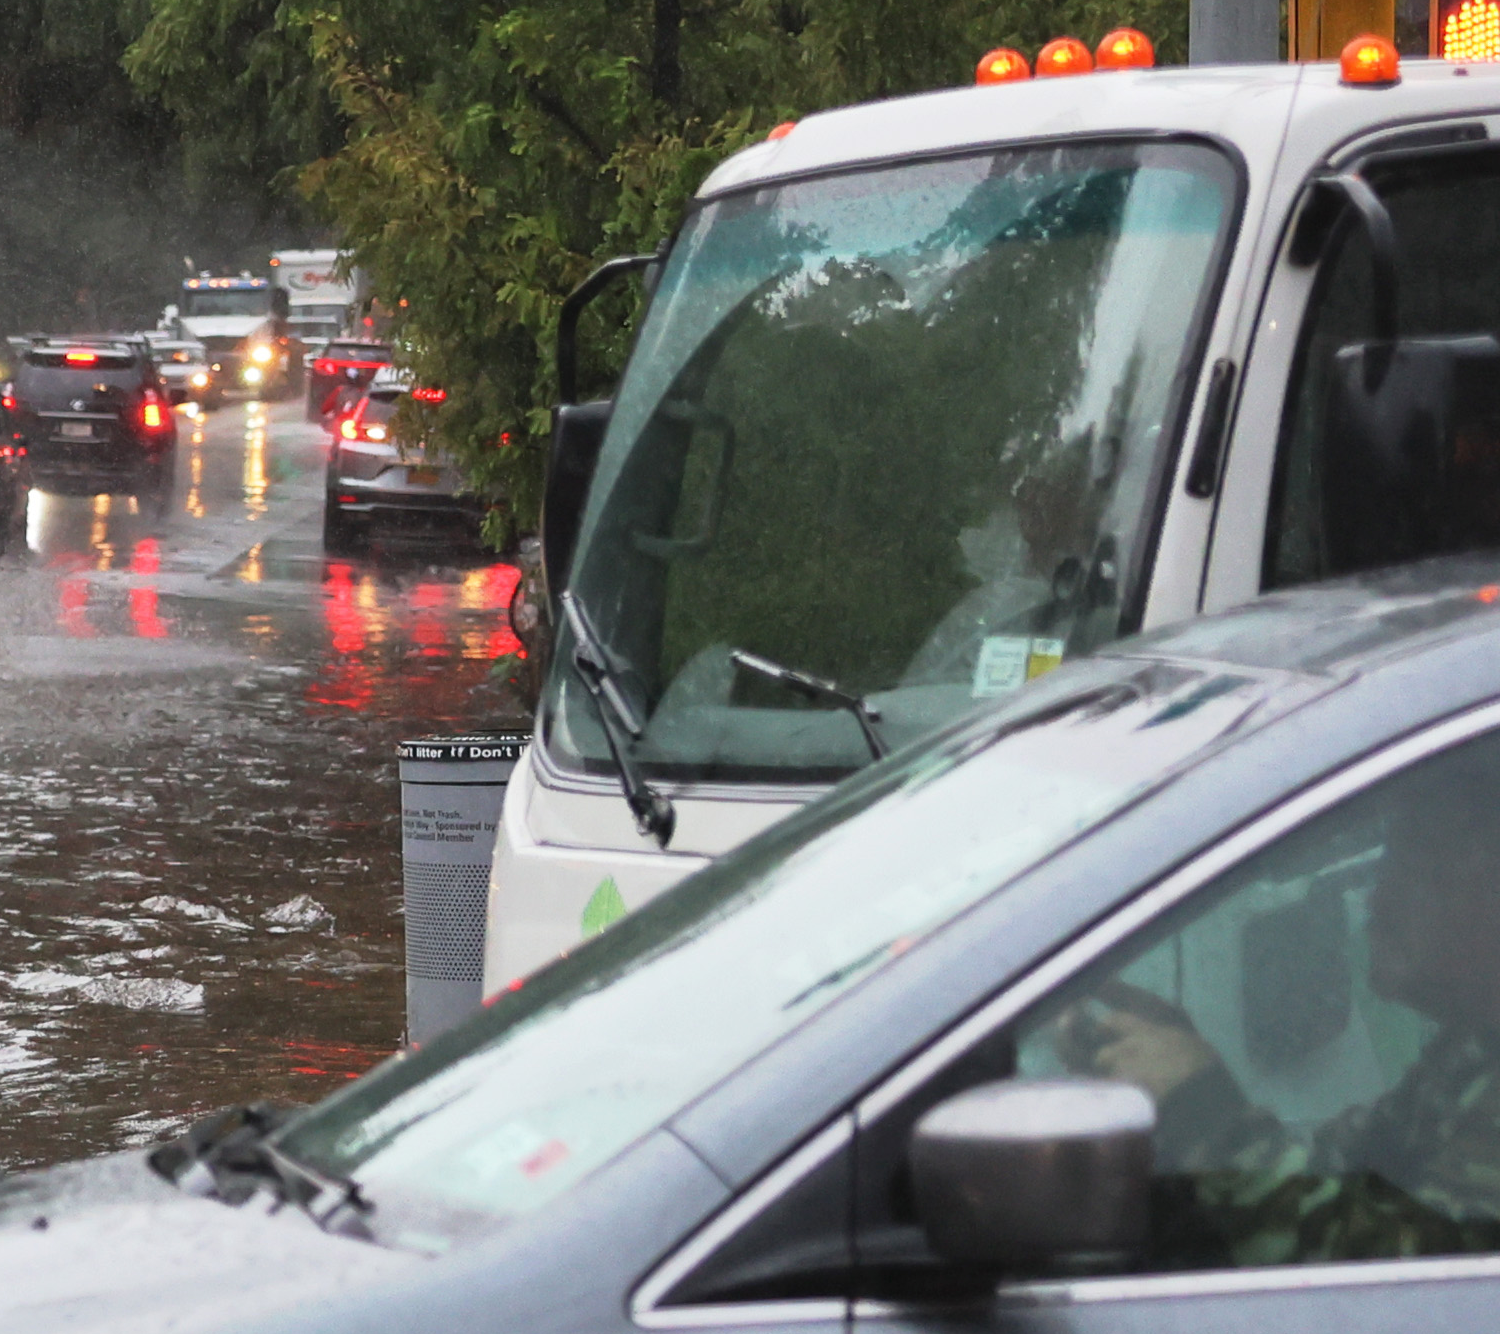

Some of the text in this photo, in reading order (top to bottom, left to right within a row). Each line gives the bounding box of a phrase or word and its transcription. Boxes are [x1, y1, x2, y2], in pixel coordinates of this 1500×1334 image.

[416, 747, 443, 759] litter
[469, 746, 512, 759] Don't
[435, 820, 482, 832] Sponsored
[437, 832, 475, 843] Member
